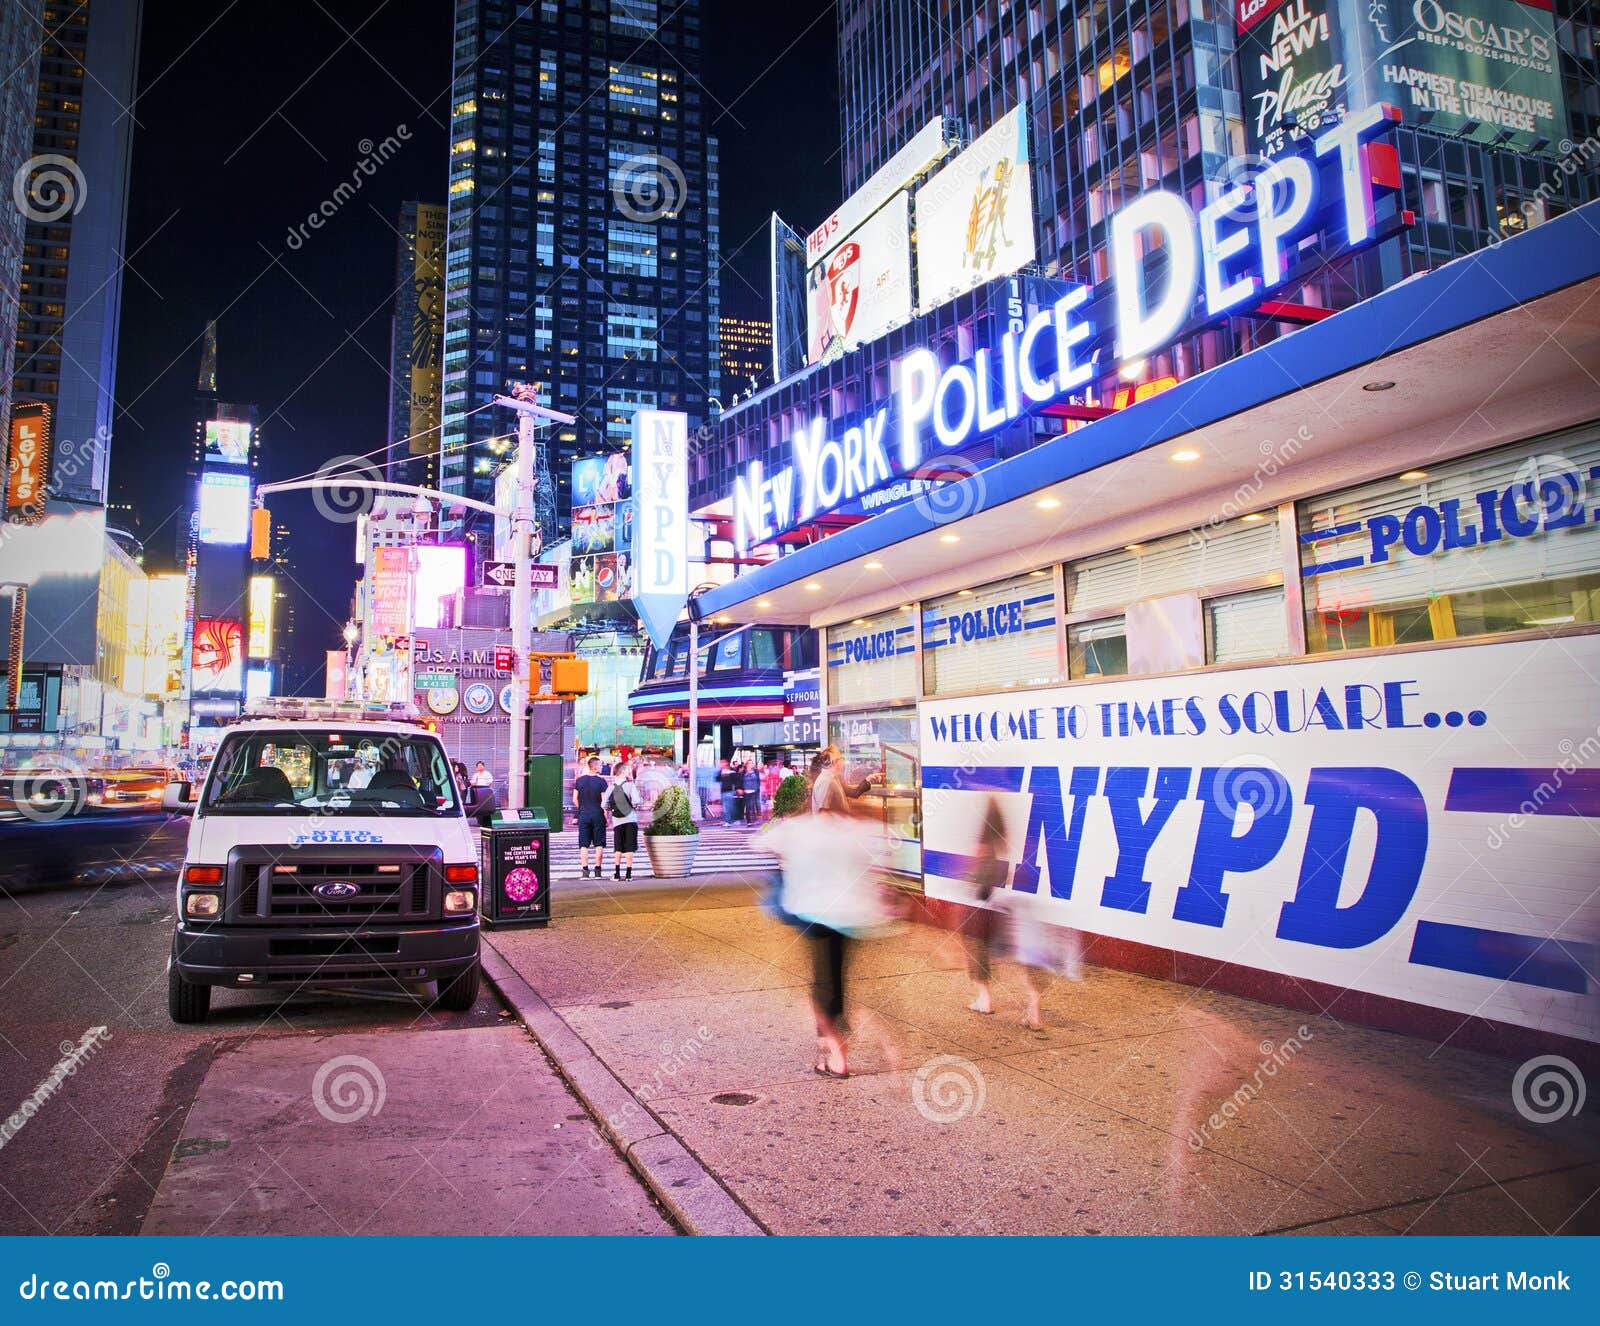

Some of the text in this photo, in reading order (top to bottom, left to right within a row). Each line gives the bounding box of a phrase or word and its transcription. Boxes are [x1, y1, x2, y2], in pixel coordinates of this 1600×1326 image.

[1271, 0, 1311, 45] ALL
[1413, 0, 1550, 61] OSCAR'S
[1260, 12, 1330, 80] NEW!
[1252, 64, 1352, 138] Plaza
[1296, 101, 1328, 122] CASINO
[1383, 64, 1554, 120] HAPPIEST STEAKHOUSE
[1411, 86, 1536, 132] IN THE UNIVERSE
[1289, 103, 1346, 142] VEGS
[736, 103, 1390, 554] NEW YORK POLICE DEPT
[653, 419, 675, 586] NYPD
[1366, 472, 1586, 564] POLICE
[495, 569, 515, 580] ONE
[949, 600, 1022, 645] POLICE
[449, 649, 496, 664] ARME
[845, 630, 895, 663] POLICE
[786, 690, 818, 703] SEPHORA
[930, 708, 1047, 743] WELCOME
[1052, 704, 1088, 740] TO
[1096, 696, 1206, 738] TIMES
[295, 835, 383, 843] POLICE
[1012, 766, 1429, 950] NYPD
[326, 887, 347, 895] Ford
